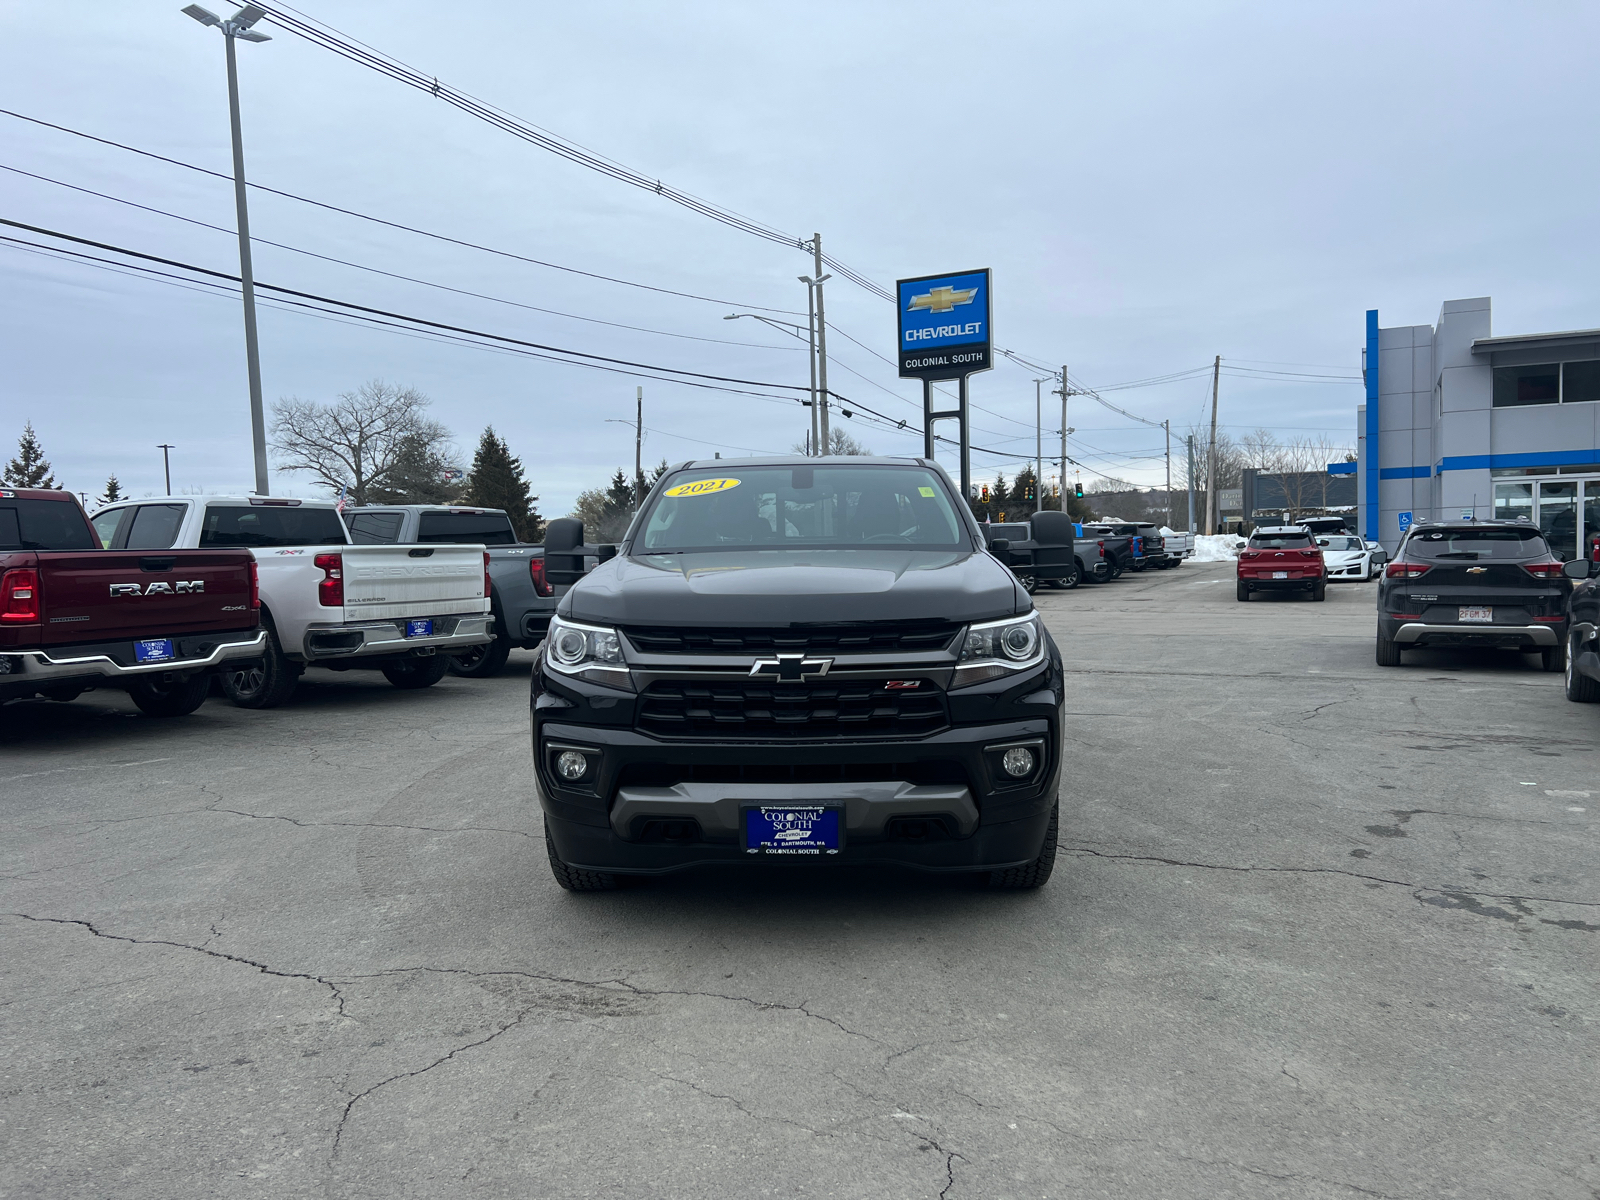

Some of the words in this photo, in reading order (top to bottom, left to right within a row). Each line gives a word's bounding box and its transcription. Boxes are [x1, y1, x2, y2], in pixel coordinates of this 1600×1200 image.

[905, 322, 982, 341] CHEVROLET
[905, 356, 949, 368] COLONIAL
[952, 352, 983, 363] SOUTH
[677, 480, 727, 495] 2021
[357, 566, 479, 578] CHEVROLET
[109, 580, 205, 597] RAM
[884, 680, 921, 689] Z71
[764, 811, 821, 821] COLONIAL
[773, 820, 812, 830] SOUTH
